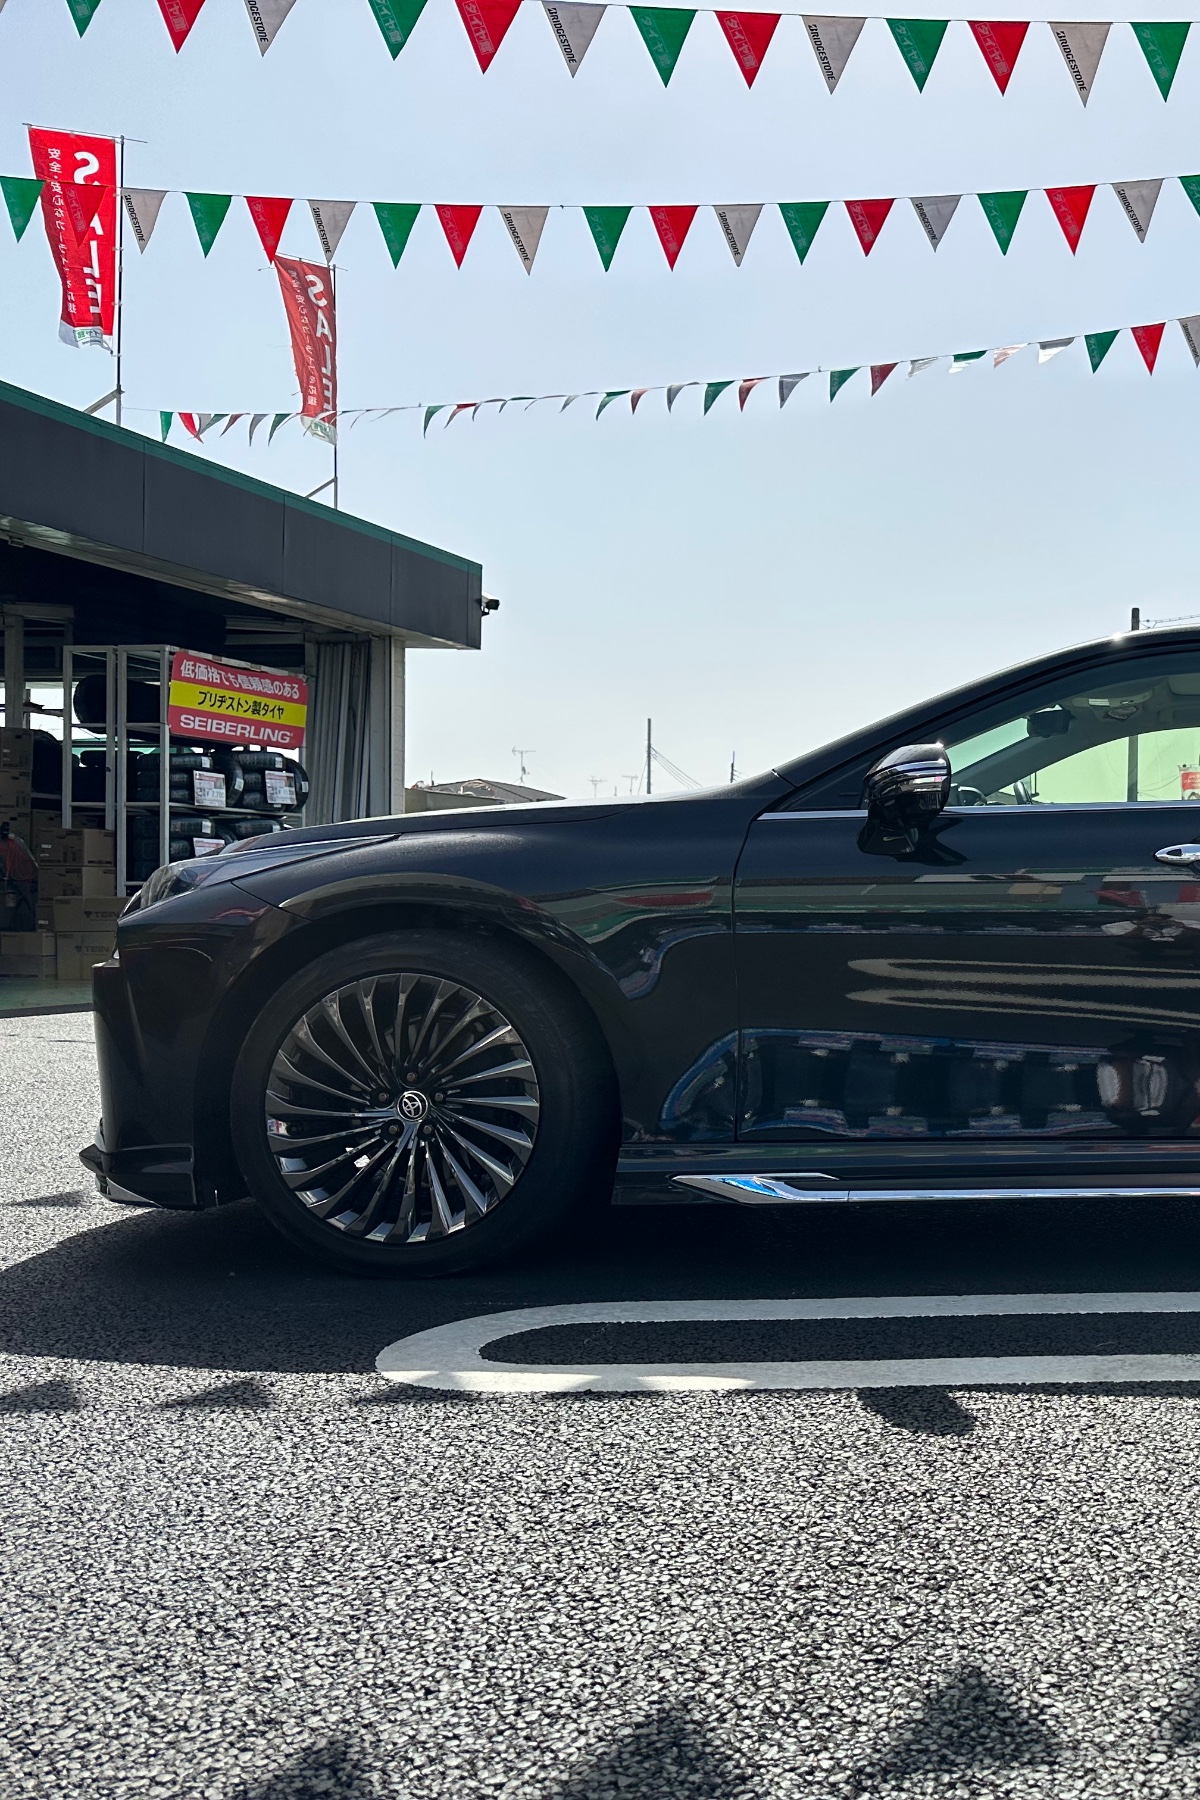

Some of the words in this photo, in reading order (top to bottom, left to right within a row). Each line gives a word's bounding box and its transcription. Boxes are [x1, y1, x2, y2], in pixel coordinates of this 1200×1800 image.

[548, 7, 577, 64] BRIDGESTONE
[808, 24, 836, 81] BRIDGESTONE
[1056, 30, 1087, 92] BRIDGESTONE
[124, 194, 146, 243] BRIDGESTONE
[312, 207, 332, 254] BRIDGESTONE
[719, 211, 741, 257] BRIDGESTONE
[916, 202, 938, 241] BRIDGESTONE
[1118, 189, 1145, 234] BRIDGESTONE
[504, 212, 531, 262] BRIDGESTONE
[181, 660, 299, 699] 低価格でも信頼感のある
[180, 714, 291, 743] SEIBERLING
[198, 691, 284, 720] ブリヂストン製タイヤ
